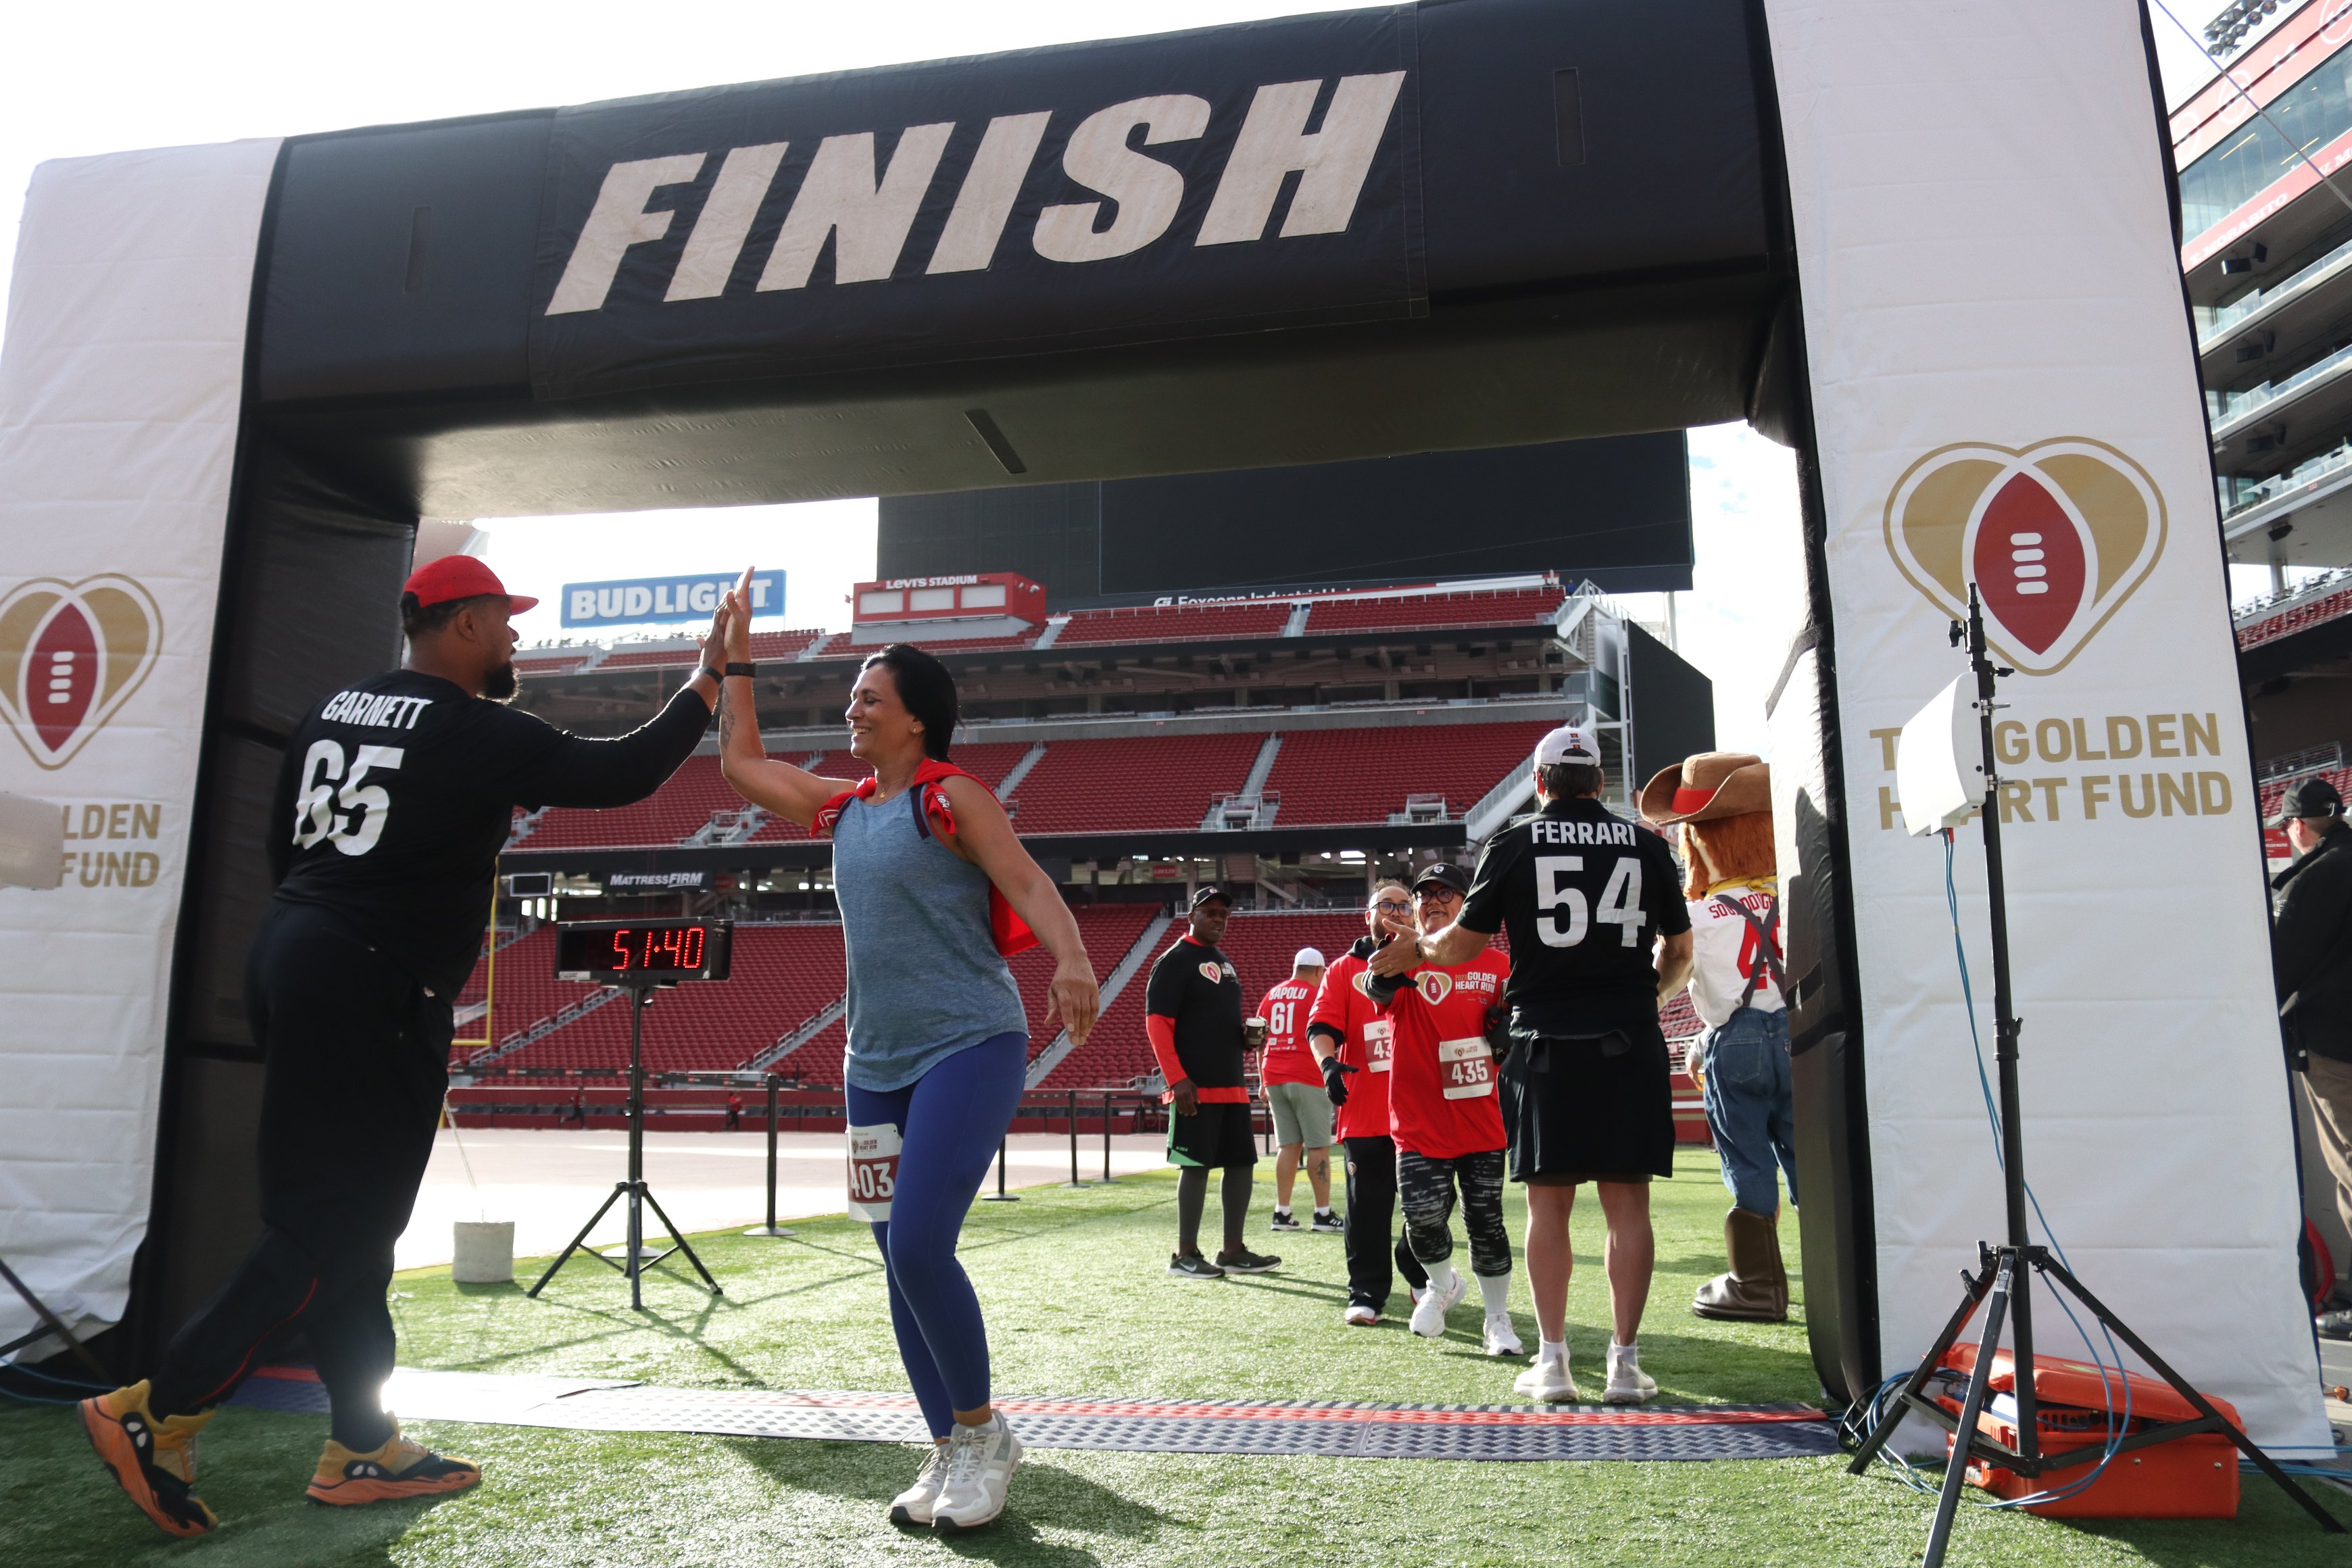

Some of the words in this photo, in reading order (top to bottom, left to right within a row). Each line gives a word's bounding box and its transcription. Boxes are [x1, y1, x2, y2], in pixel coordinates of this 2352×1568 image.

[543, 70, 1408, 316] FINISH
[2202, 193, 2288, 258] MORABITO
[929, 574, 977, 586] STADIUM
[570, 586, 652, 620] BUD
[321, 690, 435, 730] GARNETT
[1994, 713, 2221, 764] GOLDEN
[292, 739, 405, 856] 65
[1878, 777, 2068, 830] HRT
[2081, 771, 2232, 820] FUND
[62, 804, 162, 839] LDEN
[1530, 820, 1636, 846] FERRARI
[55, 852, 160, 887] FUND
[1534, 856, 1646, 948] 54
[1269, 987, 1308, 1000] SAPOLU
[1455, 981, 1479, 990] HEART
[1480, 981, 1496, 994] RUN
[1467, 971, 1497, 984] GOLDEN
[1271, 1002, 1295, 1035] 61
[1373, 1039, 1391, 1059] 43
[1451, 1059, 1488, 1085] 435
[851, 1162, 894, 1199] 403
